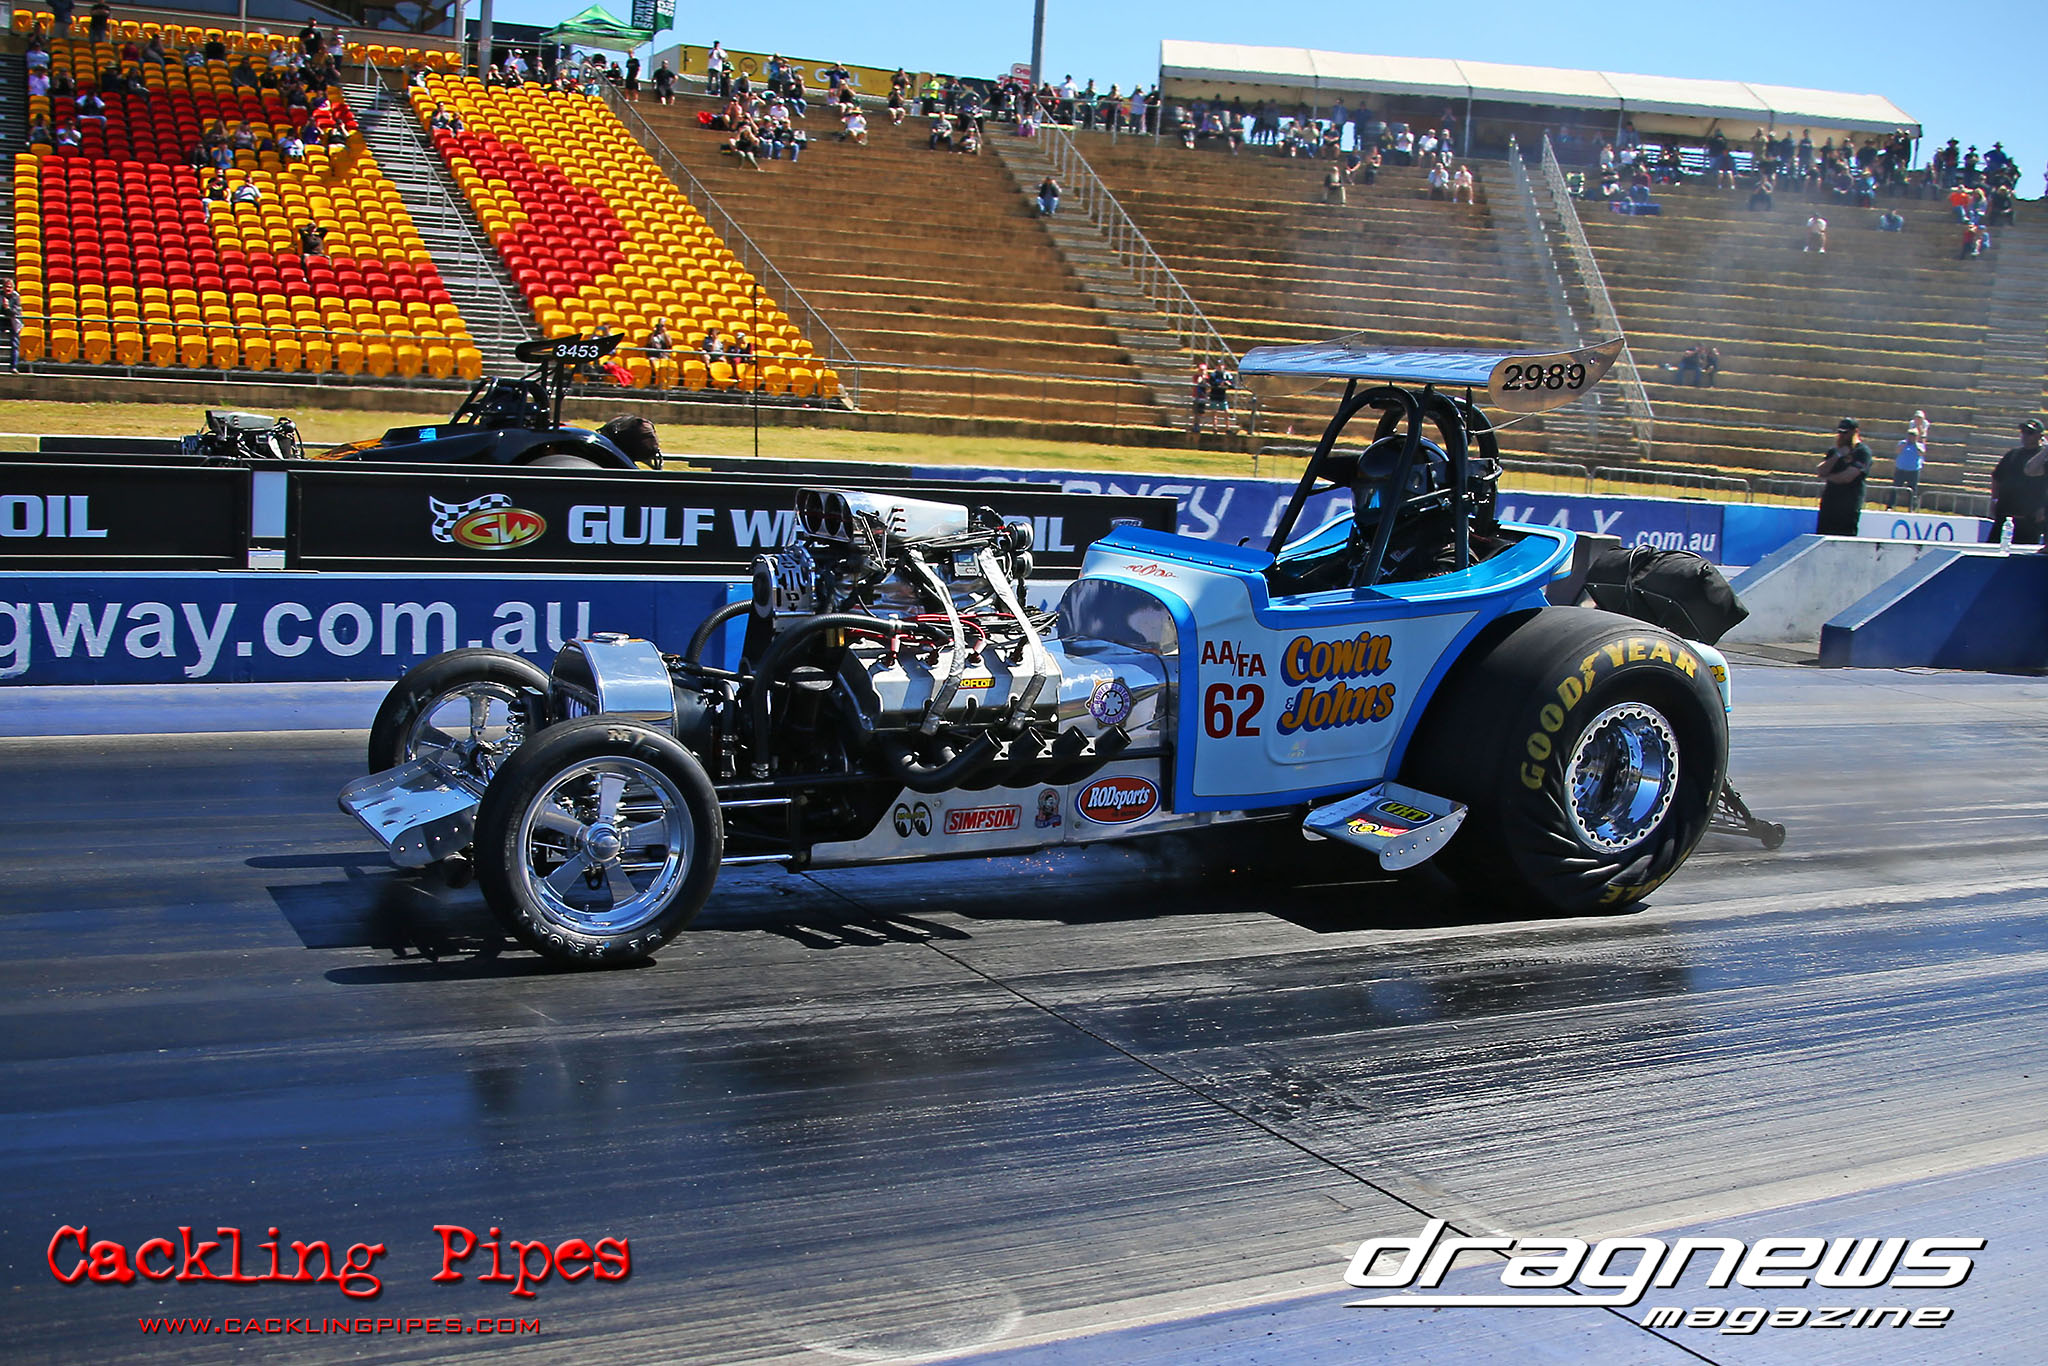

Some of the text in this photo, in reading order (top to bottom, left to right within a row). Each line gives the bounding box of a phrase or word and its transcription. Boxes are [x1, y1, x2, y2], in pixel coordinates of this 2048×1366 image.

[556, 344, 599, 358] 3453
[1502, 362, 1587, 391] 2989
[0, 494, 108, 537] OIL
[460, 514, 537, 544] GW
[568, 504, 715, 546] GULF
[1628, 530, 1716, 552] .com.au
[1201, 640, 1267, 677] AA/FA
[1280, 631, 1392, 687] Cowin
[1204, 683, 1265, 739] 62
[1276, 681, 1396, 736] Johns
[1521, 638, 1699, 790] GOODYEAR
[1088, 785, 1150, 810] RODsports
[1385, 803, 1427, 821] VHT
[950, 810, 1016, 831] SIMPSON
